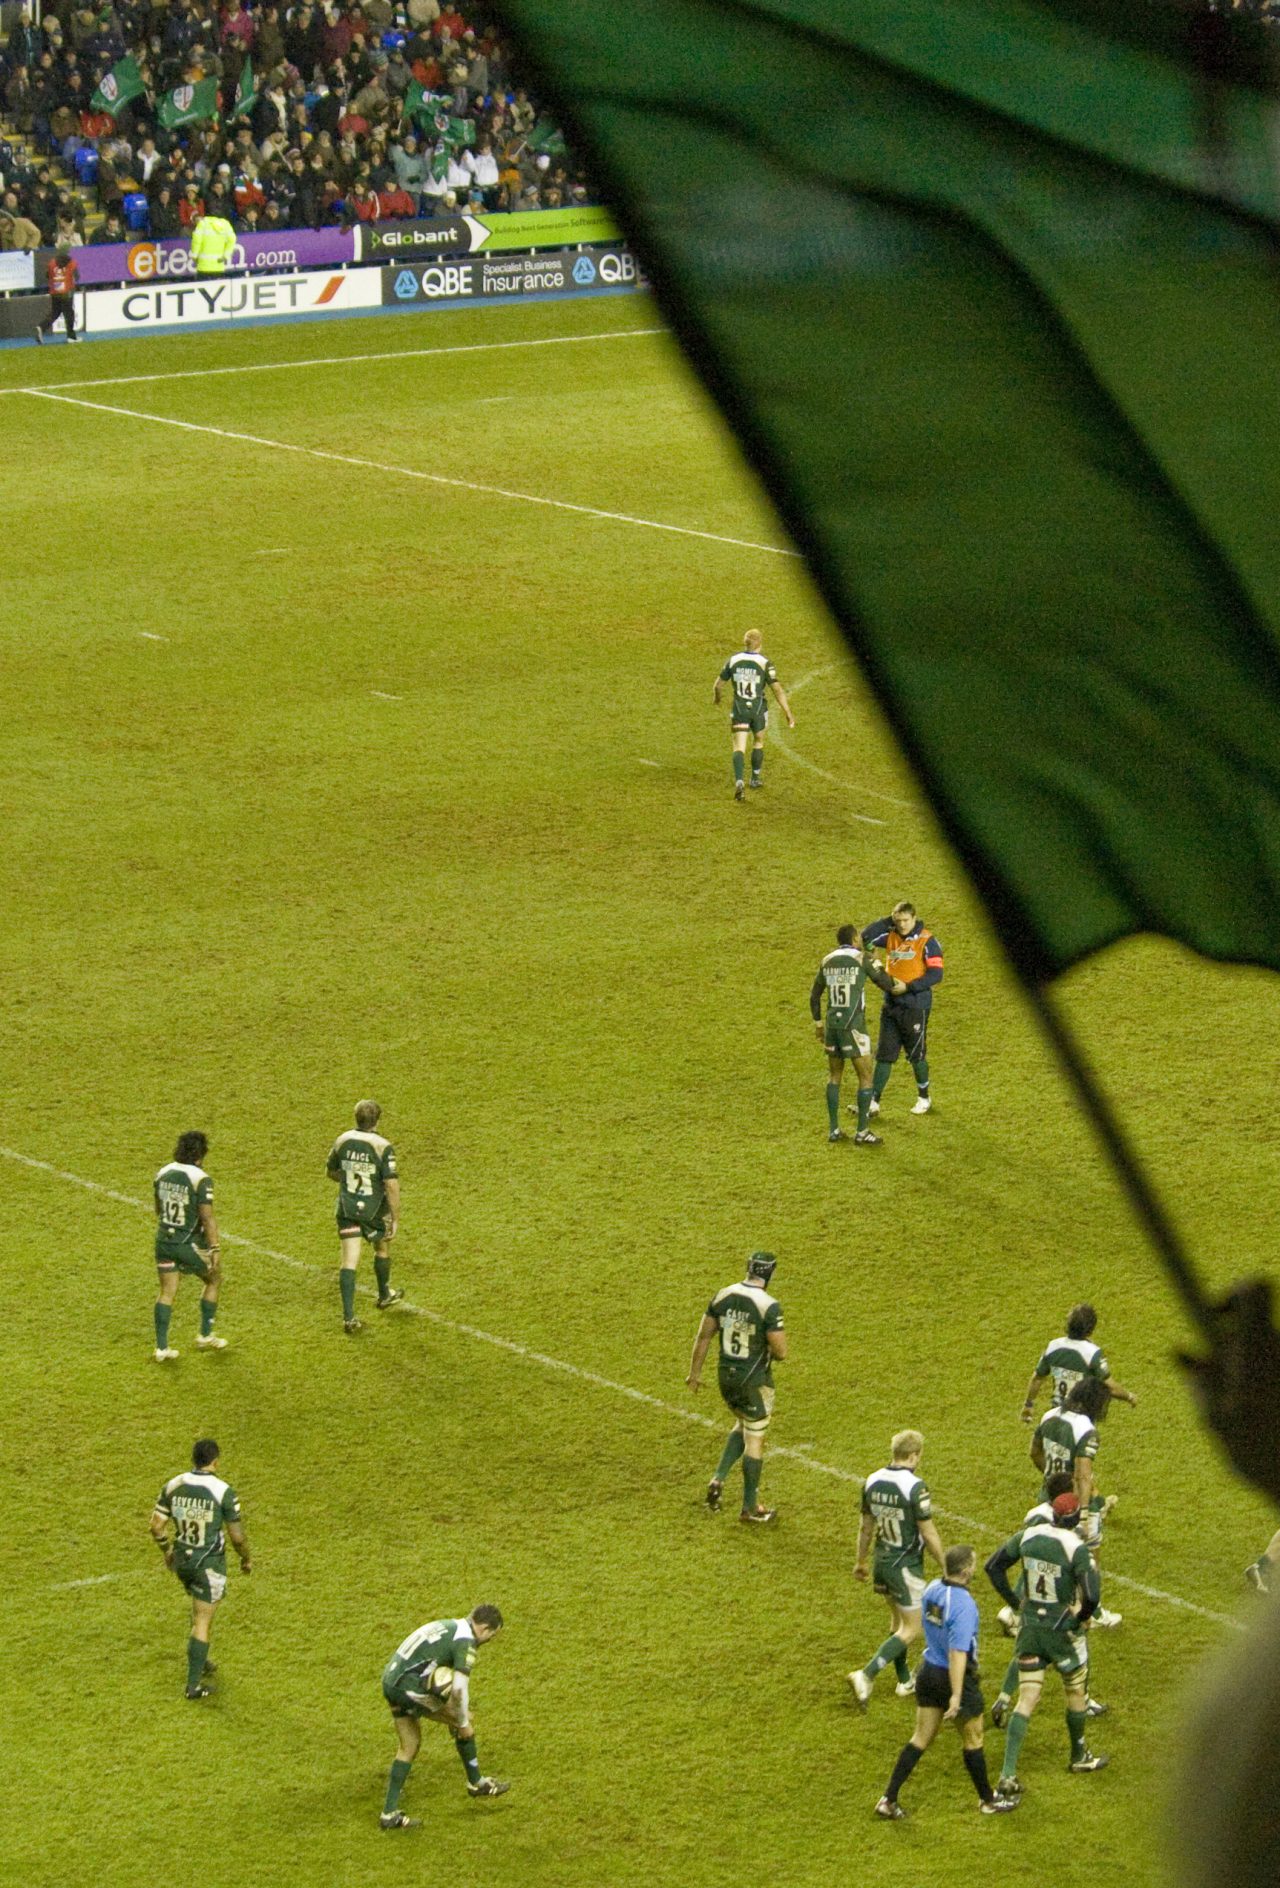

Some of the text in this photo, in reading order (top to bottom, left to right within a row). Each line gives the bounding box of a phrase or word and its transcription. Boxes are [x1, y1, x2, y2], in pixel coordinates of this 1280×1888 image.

[382, 227, 458, 246] Globant
[483, 259, 562, 275] Specialist Business
[599, 253, 640, 282] QB
[422, 265, 472, 297] QBE
[483, 271, 564, 293] Insurance
[122, 279, 308, 321] CITYJET
[740, 681, 753, 698] 14
[833, 985, 846, 1005] 15
[166, 1201, 182, 1224] 12
[731, 1331, 741, 1355] 5
[180, 1519, 200, 1546] 13
[1036, 1574, 1048, 1600] 4
